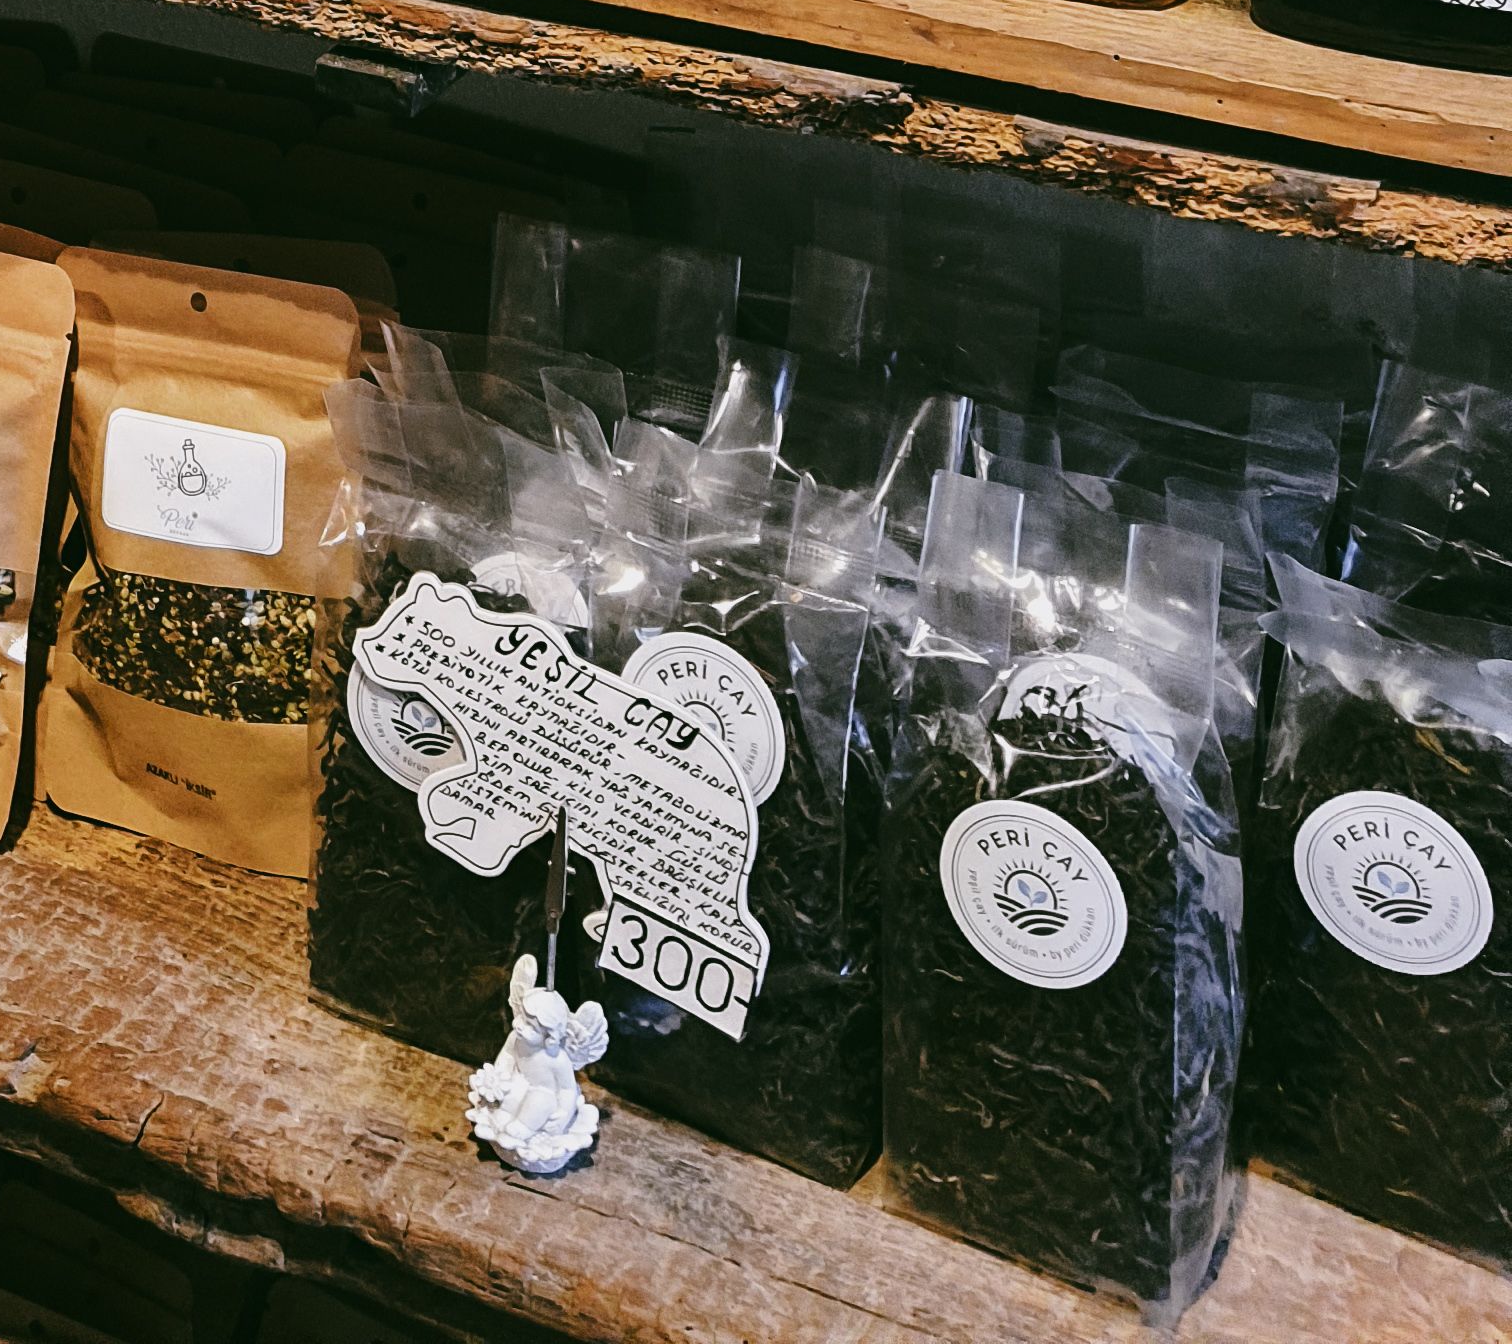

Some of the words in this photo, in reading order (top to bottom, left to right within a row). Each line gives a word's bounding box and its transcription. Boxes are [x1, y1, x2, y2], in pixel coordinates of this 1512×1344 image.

[417, 621, 456, 648] 500
[460, 646, 514, 678] YILLIK
[495, 625, 599, 705] YEŞİL
[656, 658, 708, 687] PERİ
[717, 674, 758, 718] ÇAY
[504, 728, 595, 782] ARTIRARAK
[439, 784, 497, 822] DAMAR
[976, 827, 1030, 857] PERİ
[1042, 841, 1089, 884] ÇAY
[1333, 820, 1391, 852] PERİ
[1404, 830, 1452, 873] ÇAY
